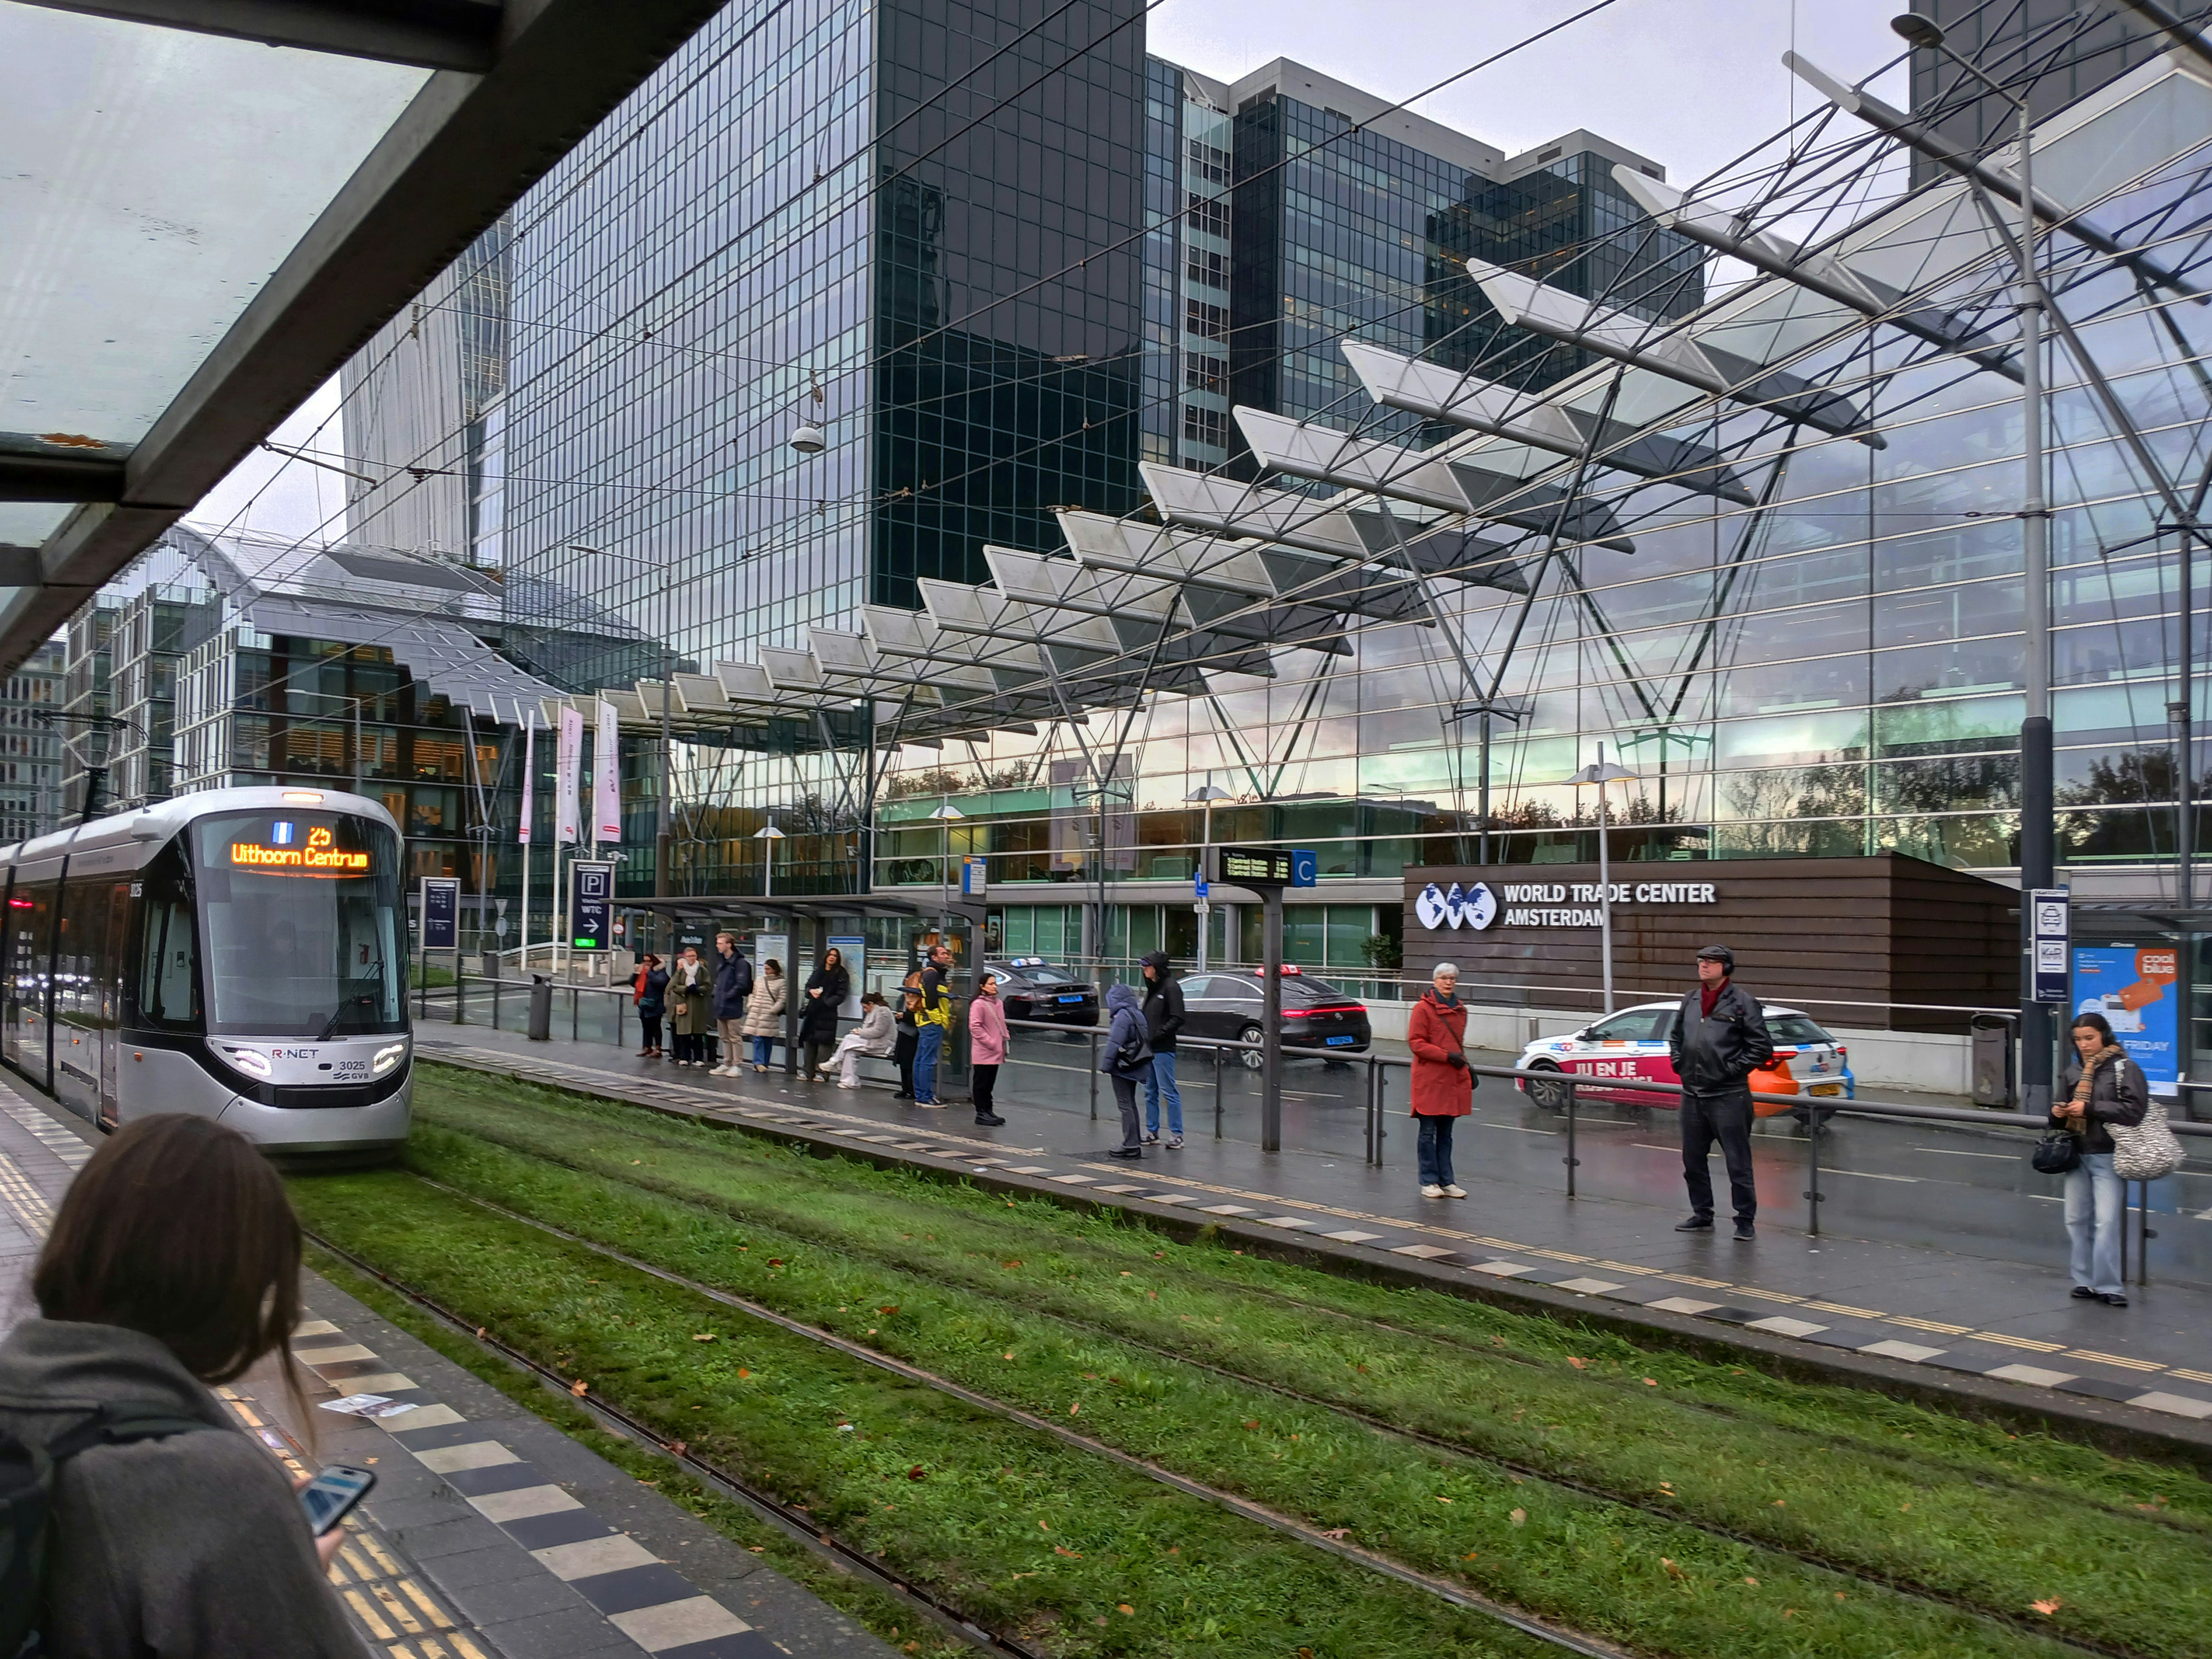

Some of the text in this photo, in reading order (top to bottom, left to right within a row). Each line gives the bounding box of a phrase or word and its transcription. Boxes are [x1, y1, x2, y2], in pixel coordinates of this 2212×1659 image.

[308, 826, 331, 846] 25
[231, 843, 369, 867] Uithoorn Centrum
[1298, 860, 1312, 881] C
[587, 876, 599, 892] P
[1504, 884, 1717, 903] WORLD TRADE CENTER
[581, 905, 602, 914] WTC
[2142, 953, 2175, 963] cool
[2142, 963, 2175, 973] blue
[2123, 1040, 2170, 1051] FRIDAY
[339, 1061, 365, 1070] 3025
[1596, 1062, 1617, 1077] EN
[1619, 1061, 1637, 1076] JE
